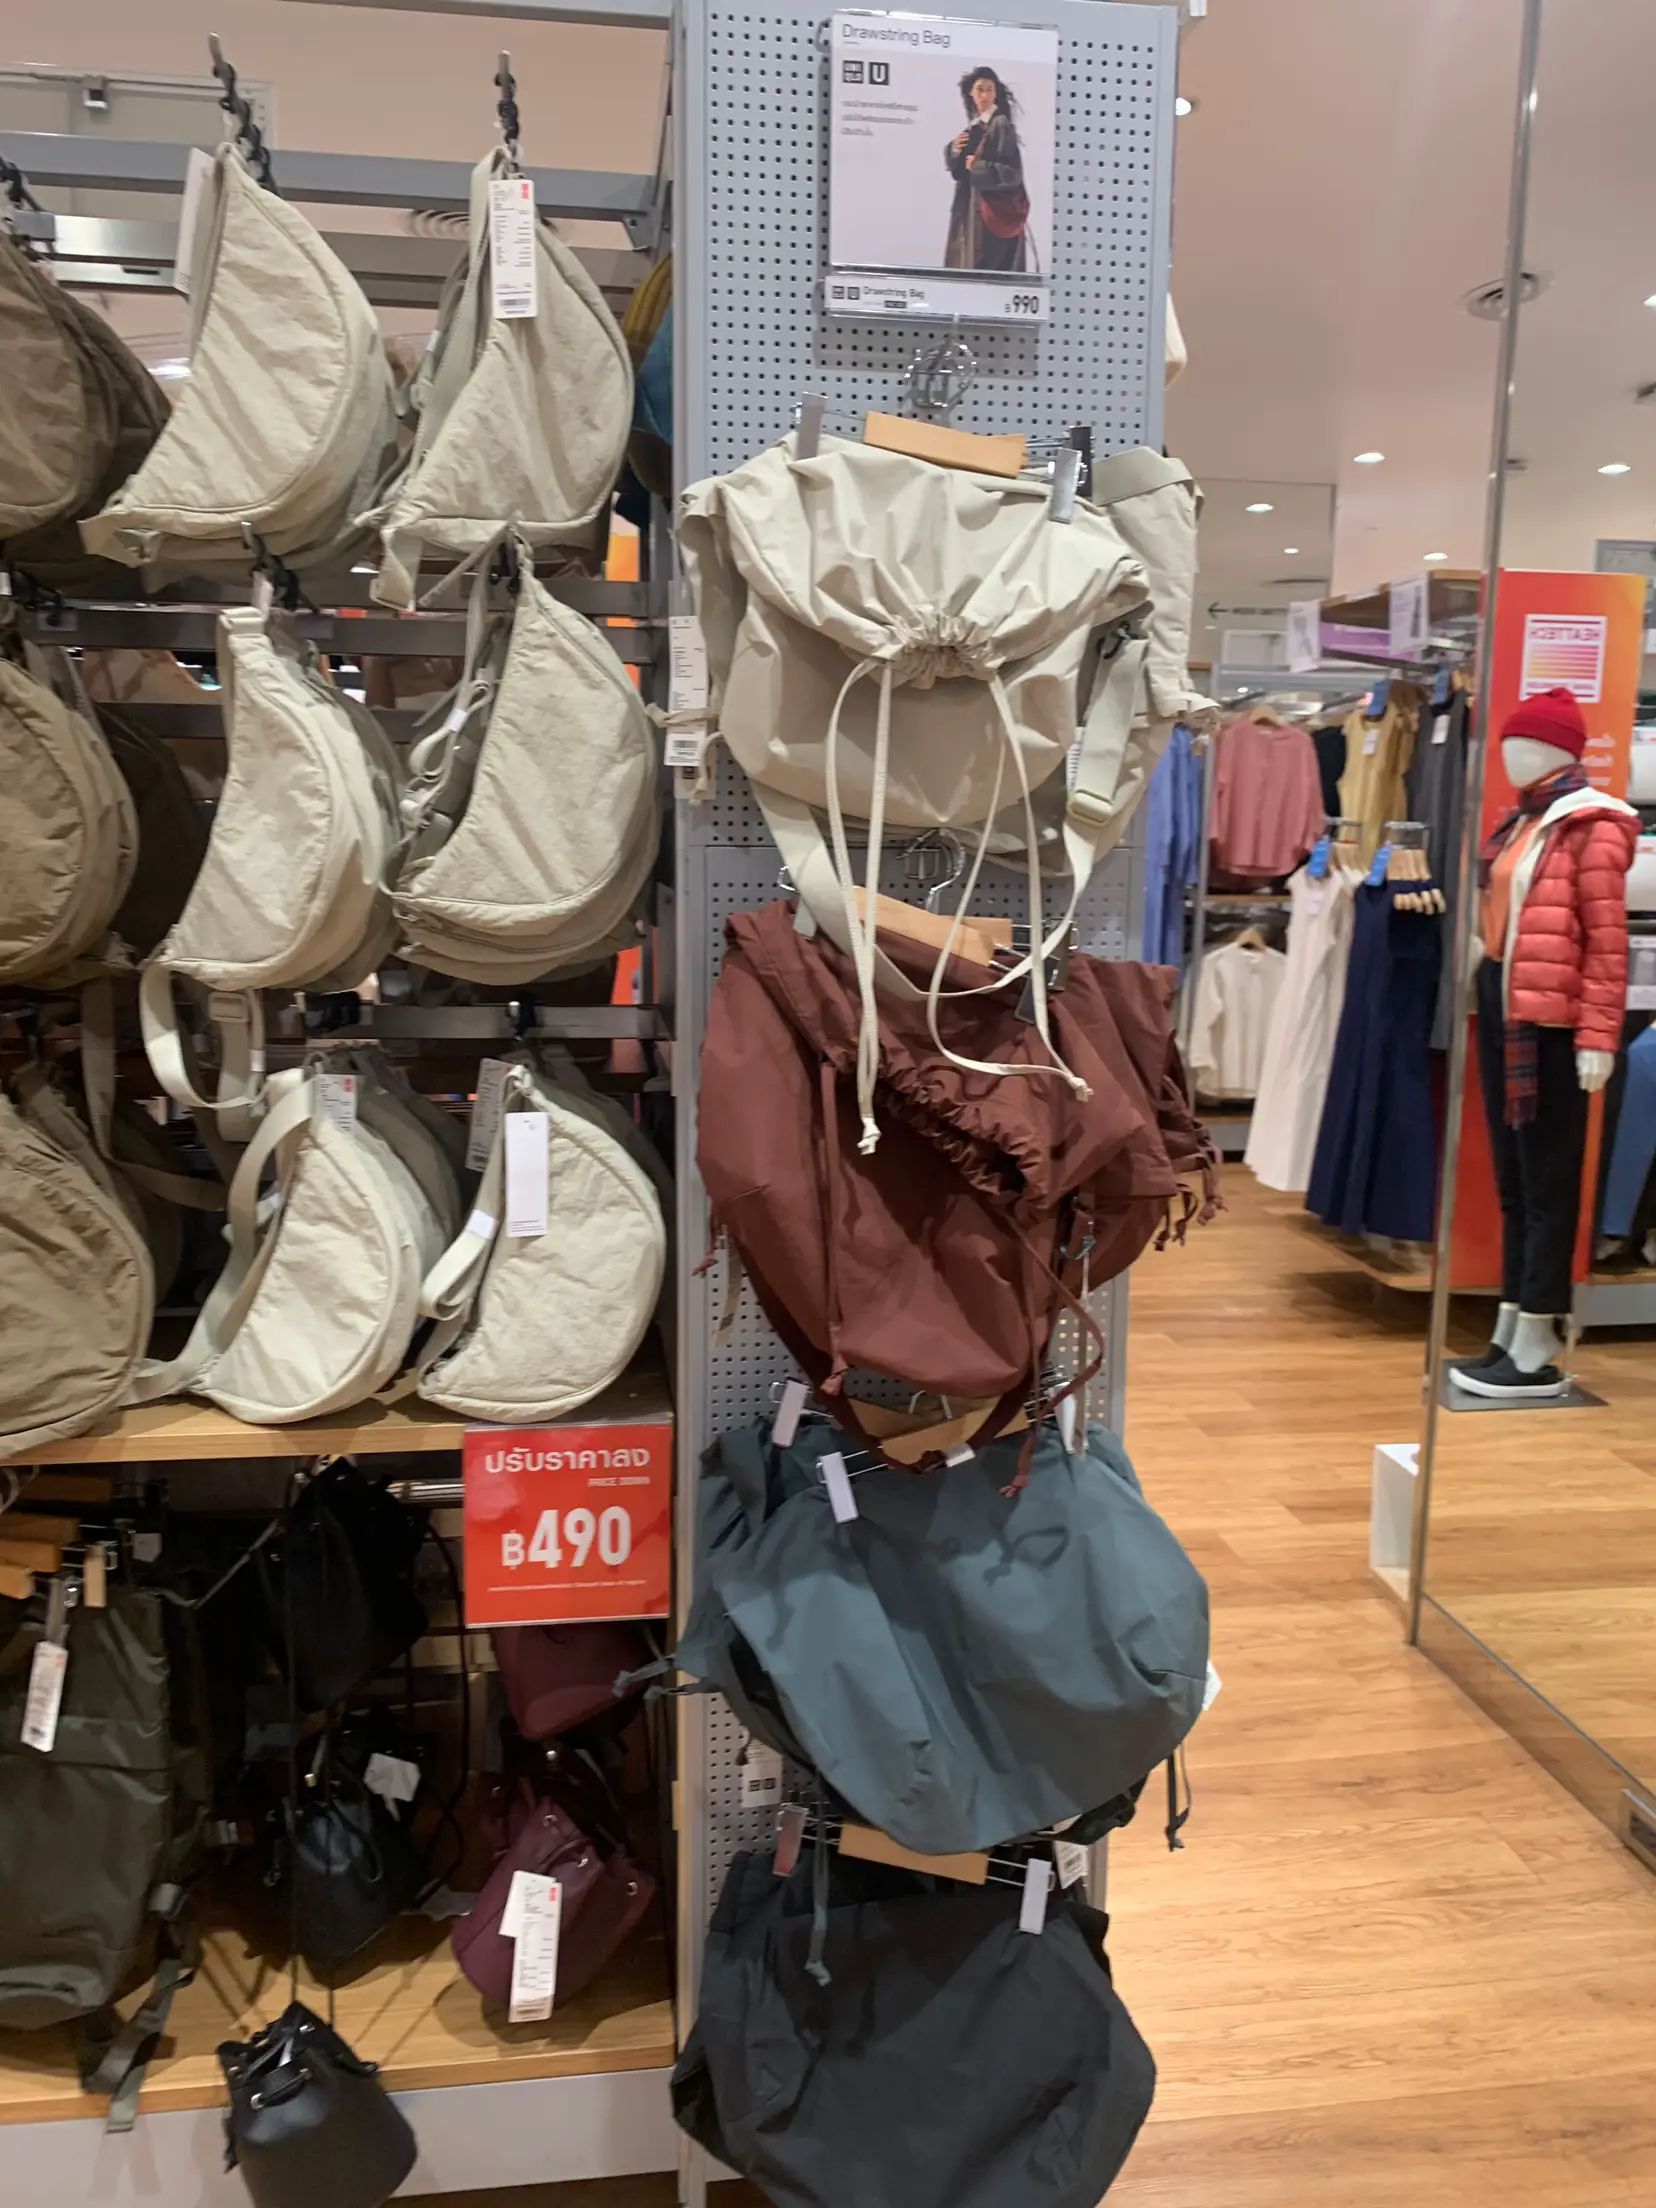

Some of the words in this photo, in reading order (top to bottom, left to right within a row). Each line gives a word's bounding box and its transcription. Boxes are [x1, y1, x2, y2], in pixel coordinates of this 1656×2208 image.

[842, 23, 919, 46] Drawstring
[923, 29, 951, 48] Bag
[484, 1446, 650, 1473] ปรับราคาลด
